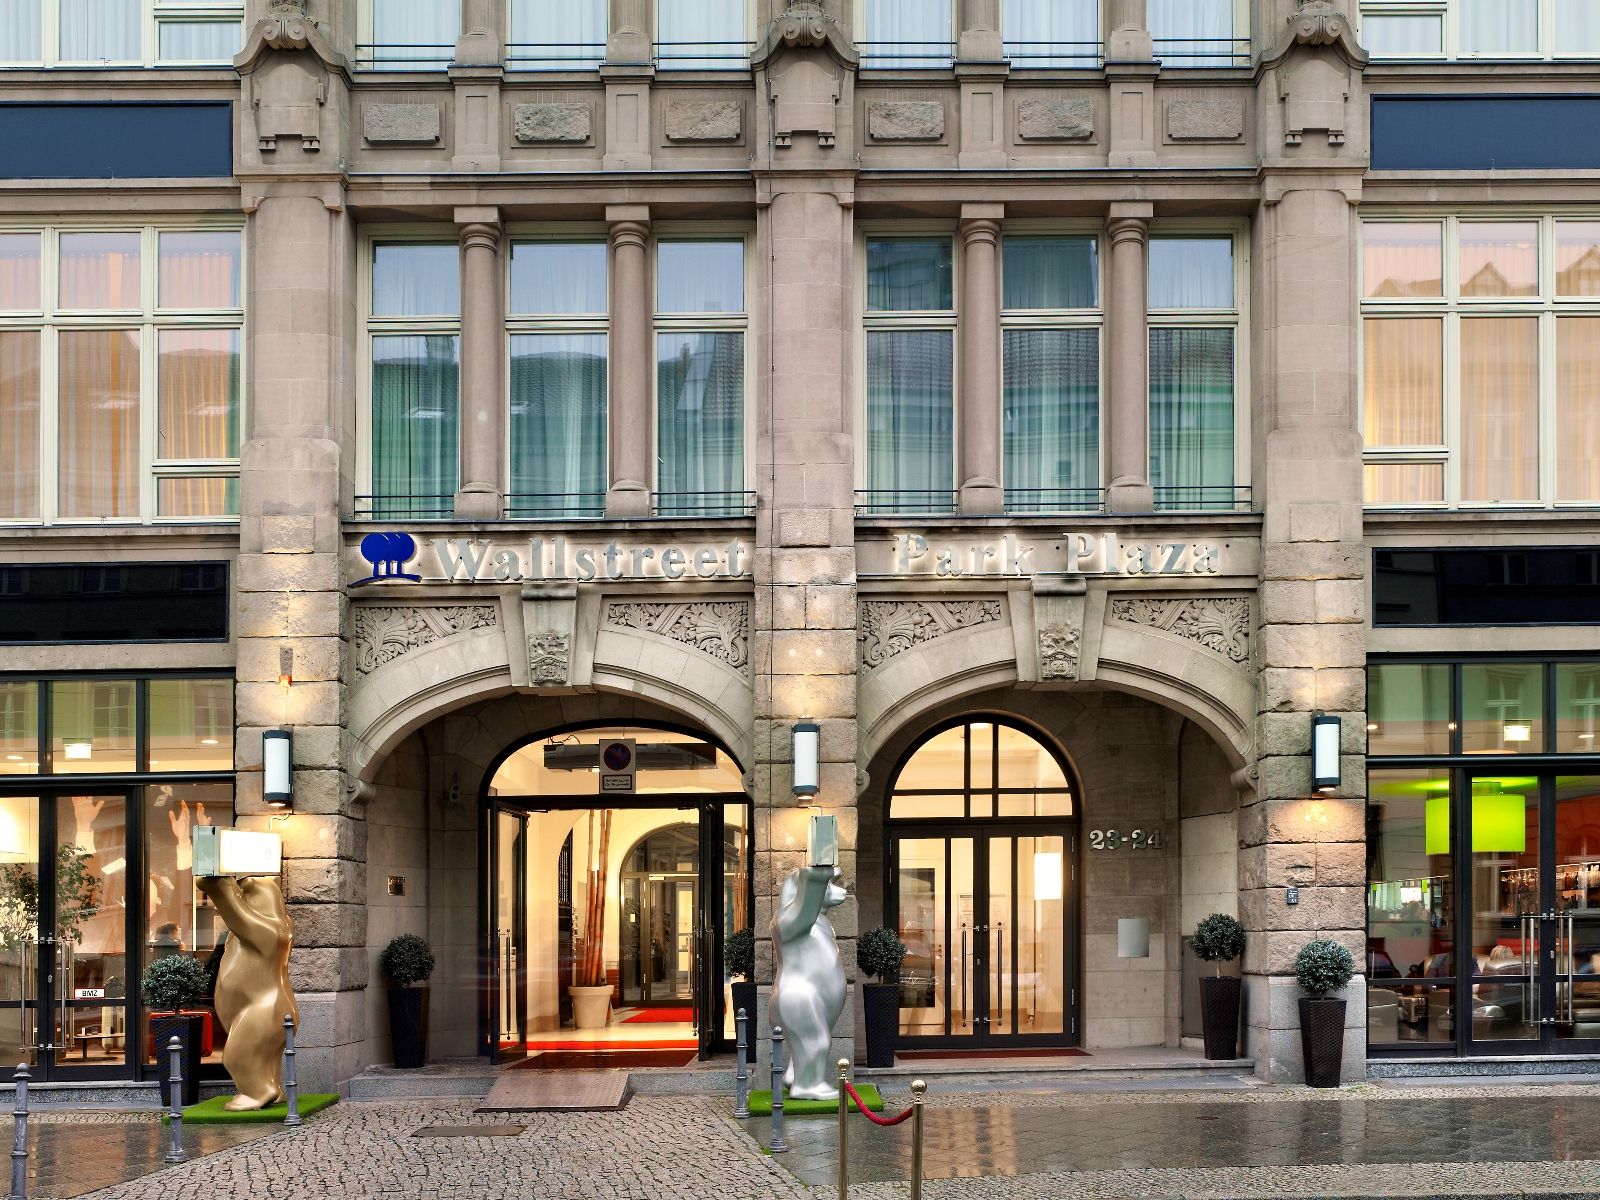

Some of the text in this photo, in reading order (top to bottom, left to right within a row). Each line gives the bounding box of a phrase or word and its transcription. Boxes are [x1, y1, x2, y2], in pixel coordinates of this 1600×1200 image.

[431, 537, 746, 583] Wallstreet
[895, 532, 1219, 576] Park Plaza
[1089, 829, 1163, 850] 23-24
